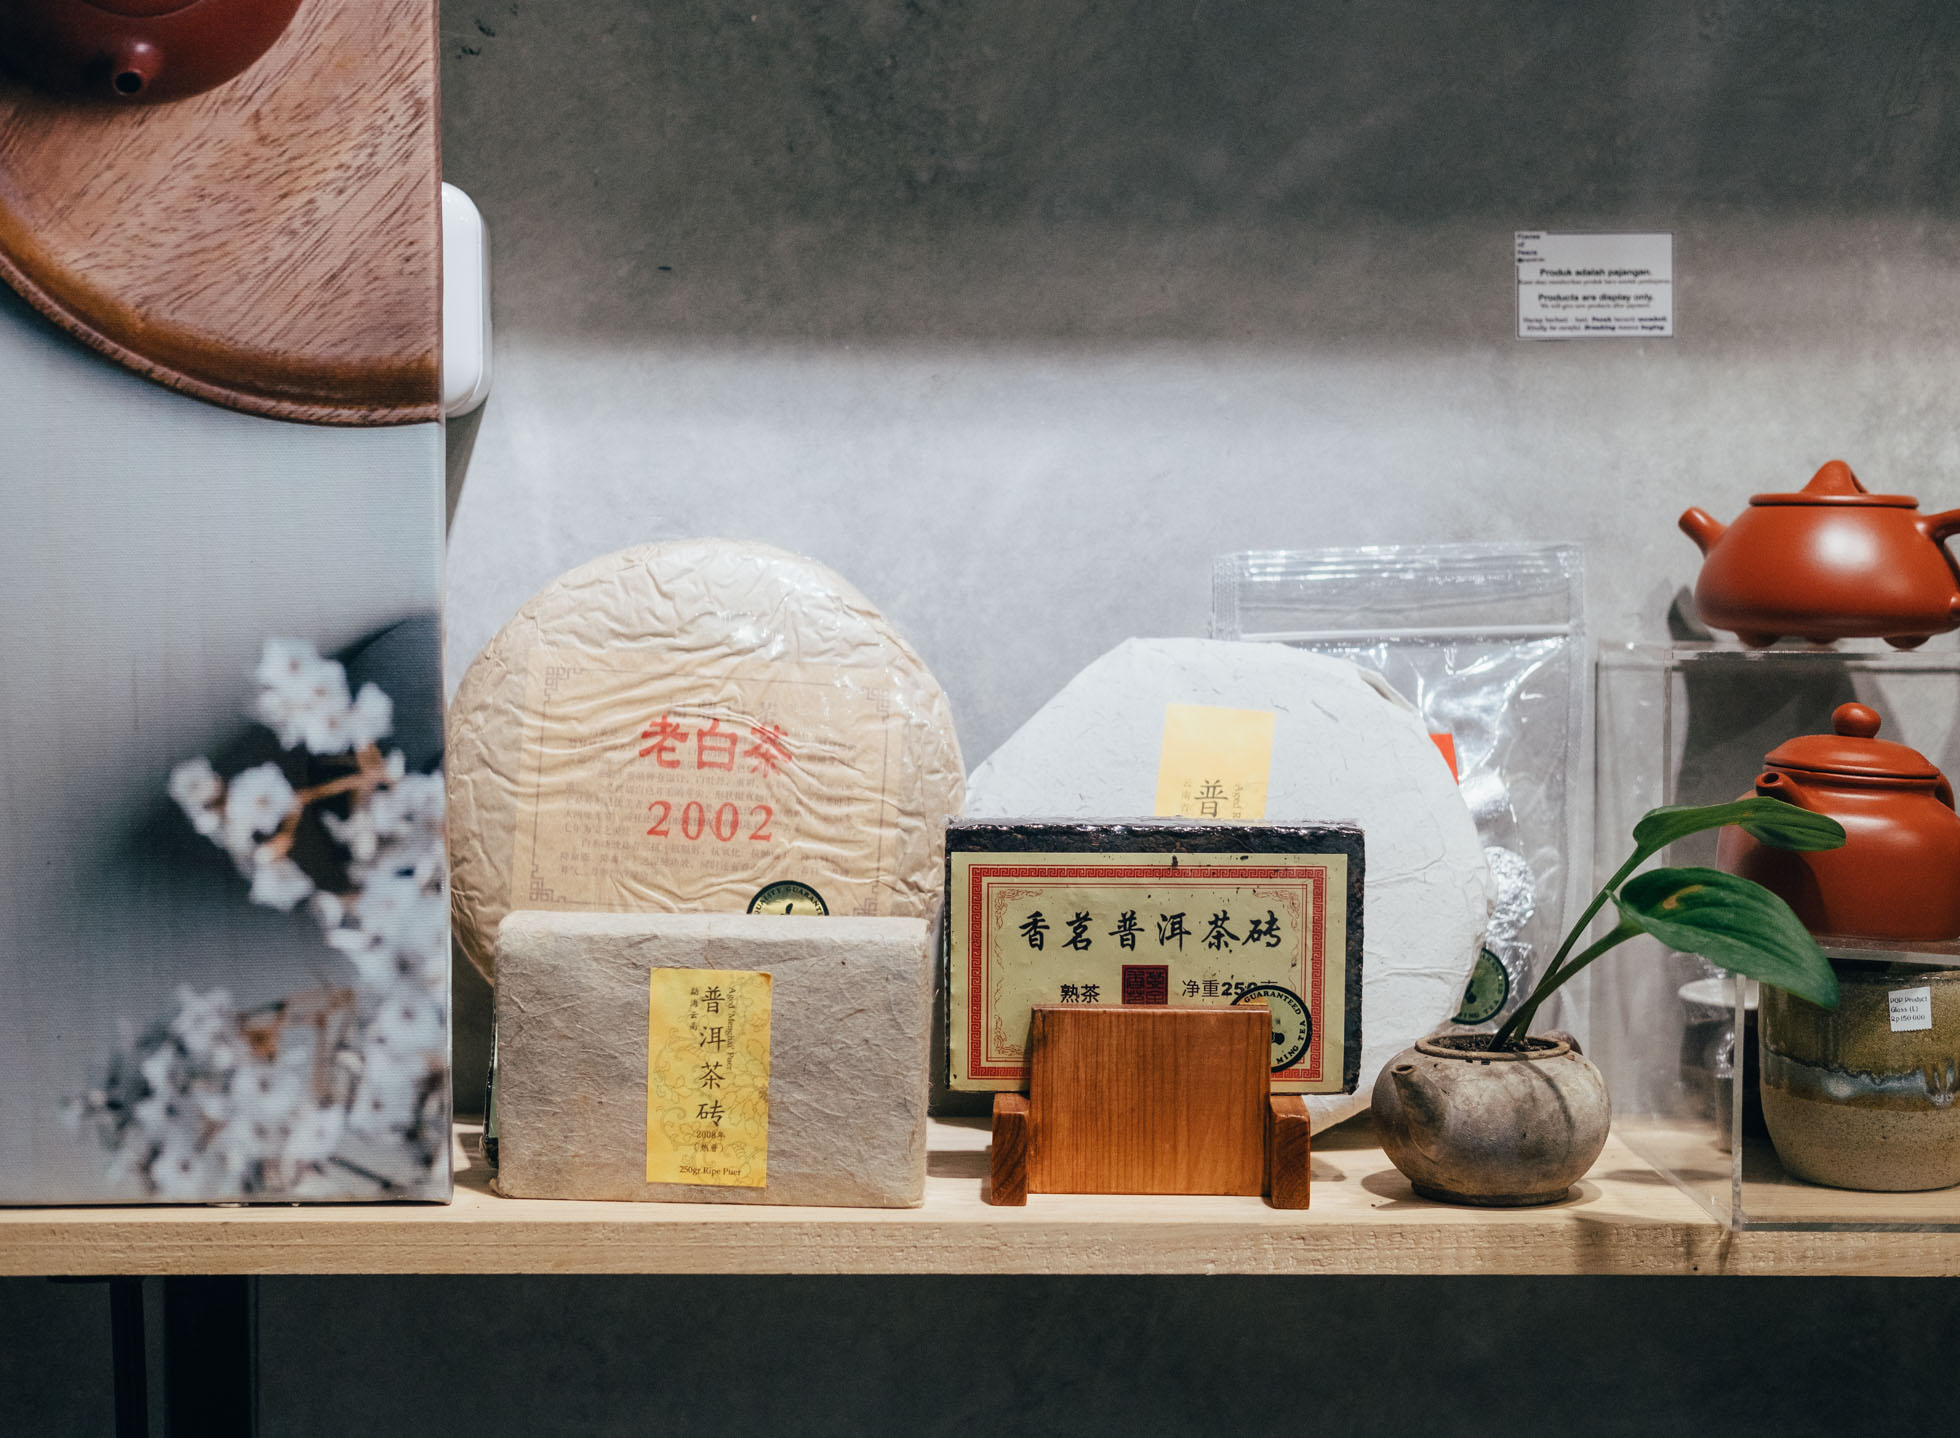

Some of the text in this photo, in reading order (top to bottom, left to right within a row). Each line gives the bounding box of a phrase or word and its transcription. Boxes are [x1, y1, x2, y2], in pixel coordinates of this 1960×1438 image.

[1540, 268, 1572, 276] Produk
[1575, 268, 1605, 276] adalah
[1538, 293, 1579, 301] Products
[1599, 293, 1631, 303] display
[639, 715, 793, 779] 老白茶
[1193, 779, 1229, 818] 普
[647, 800, 774, 842] 2002
[786, 886, 823, 915] GUARANT
[1018, 909, 1283, 953] 香茗普洱茶砖
[1060, 983, 1100, 1004] 熟茶
[1182, 979, 1278, 998] 净重25
[1244, 990, 1302, 1016] GUARANTEED
[696, 986, 726, 1127] 普洱茶砖
[1275, 1019, 1306, 1065] MING TEA
[703, 1166, 721, 1177] Ripe
[723, 1167, 742, 1176] Puer
